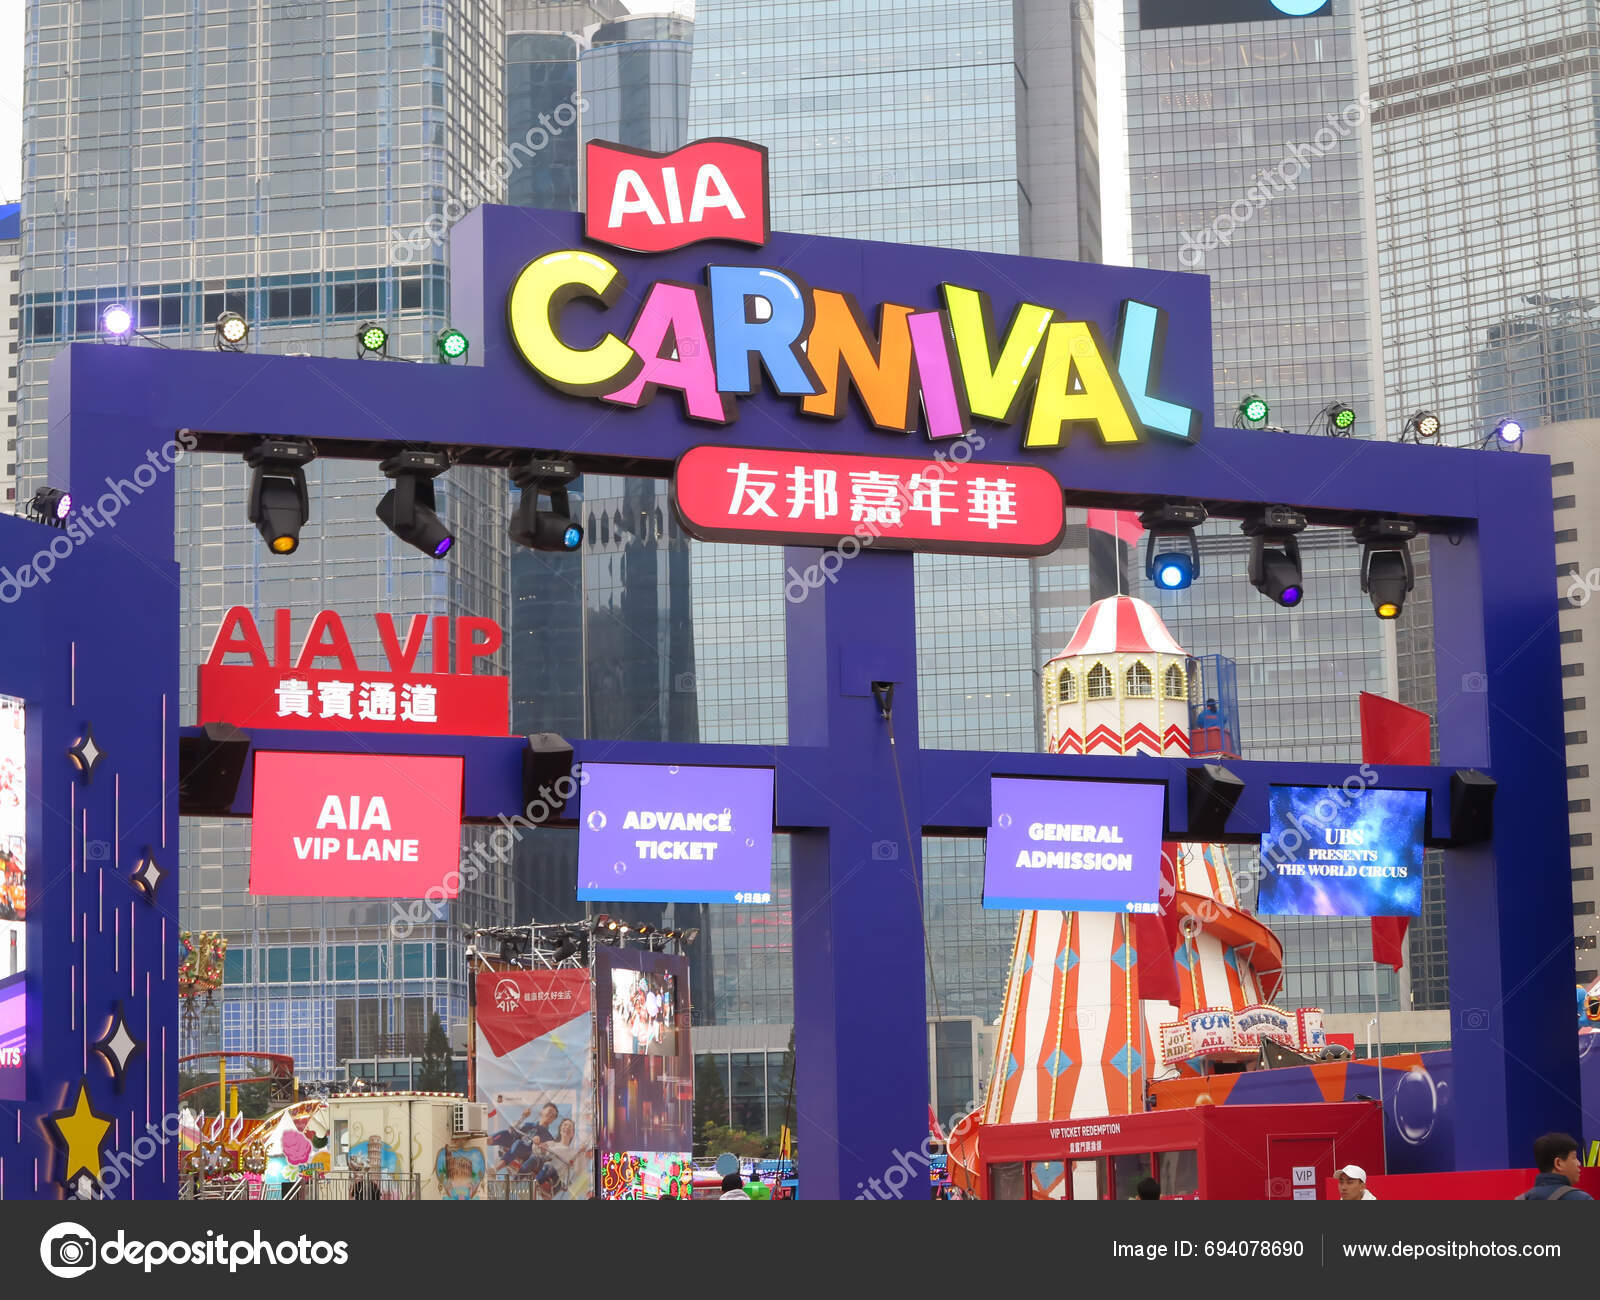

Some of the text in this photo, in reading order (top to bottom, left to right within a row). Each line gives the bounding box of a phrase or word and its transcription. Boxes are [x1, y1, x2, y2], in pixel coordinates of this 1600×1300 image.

[607, 163, 746, 228] AIA
[508, 249, 1196, 448] CARNIVAL
[726, 462, 1018, 528] 友邦嘉年華
[205, 605, 503, 675] AIA VIP
[274, 678, 438, 723] 貴賓通道
[316, 795, 392, 831] AIA
[622, 810, 732, 832] ADVANCE
[1028, 822, 1124, 844] GENERAL
[1325, 828, 1364, 845] UBS
[293, 836, 419, 862] VIP LANE
[635, 840, 719, 861] TICKET
[1308, 848, 1378, 862] PRESENTS
[1015, 849, 1133, 872] ADMISSION
[1276, 864, 1408, 878] THE WORLD CIRCUS
[496, 1000, 519, 1012] AIA
[1191, 1013, 1230, 1032] FUN
[1168, 1033, 1185, 1046] JOY
[1201, 1036, 1225, 1047] ALL
[1050, 1123, 1120, 1139] VIP TICKET REDEMPTION
[1296, 1170, 1312, 1181] VIP
